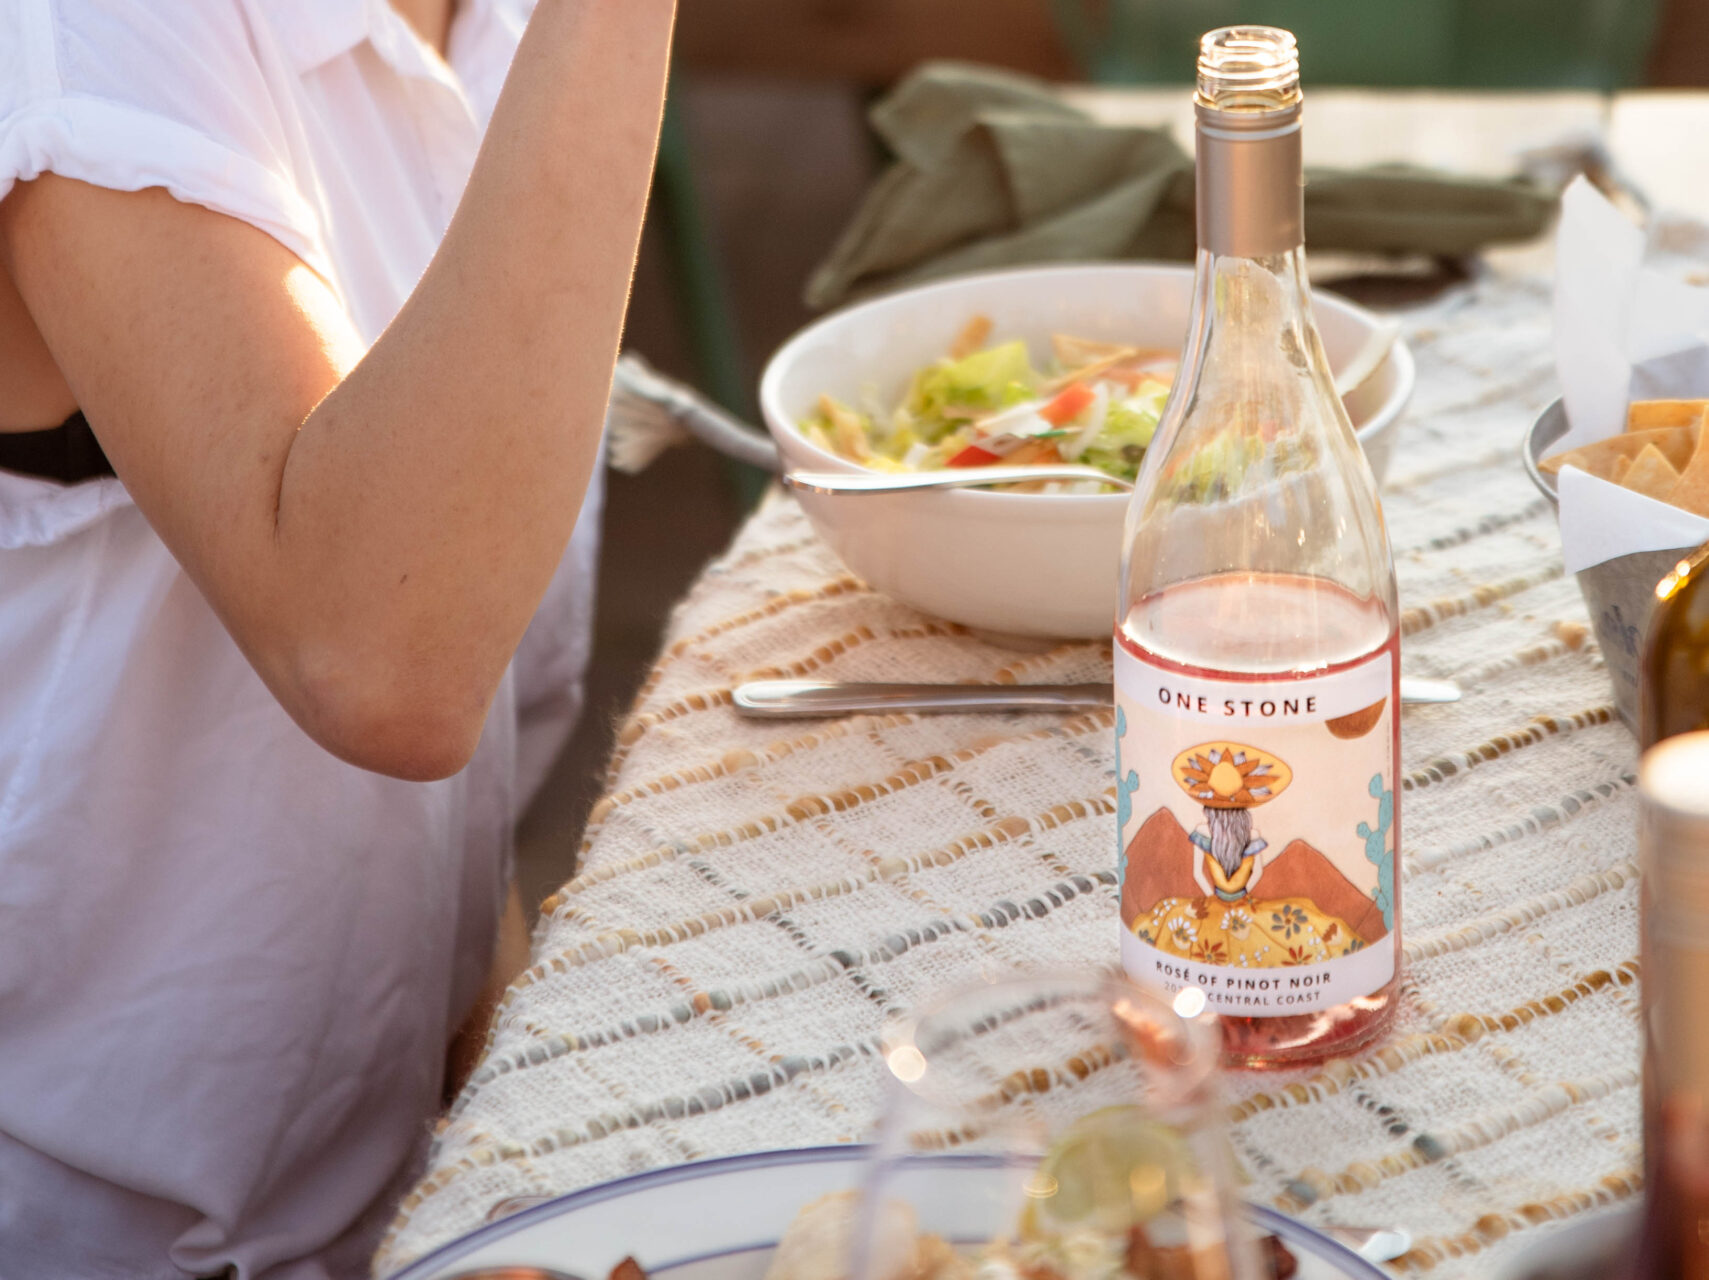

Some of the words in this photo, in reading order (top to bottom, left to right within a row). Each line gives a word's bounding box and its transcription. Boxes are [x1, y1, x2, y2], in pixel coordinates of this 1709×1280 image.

[1158, 687, 1208, 713] ONE
[1224, 696, 1317, 717] STONE
[1156, 960, 1190, 982] ROSÉ
[1198, 973, 1217, 987] OF
[1227, 978, 1280, 991] PINOT
[1290, 972, 1332, 989] NOIR
[1207, 992, 1270, 1006] CENTRAL
[1277, 991, 1321, 1006] COAST
